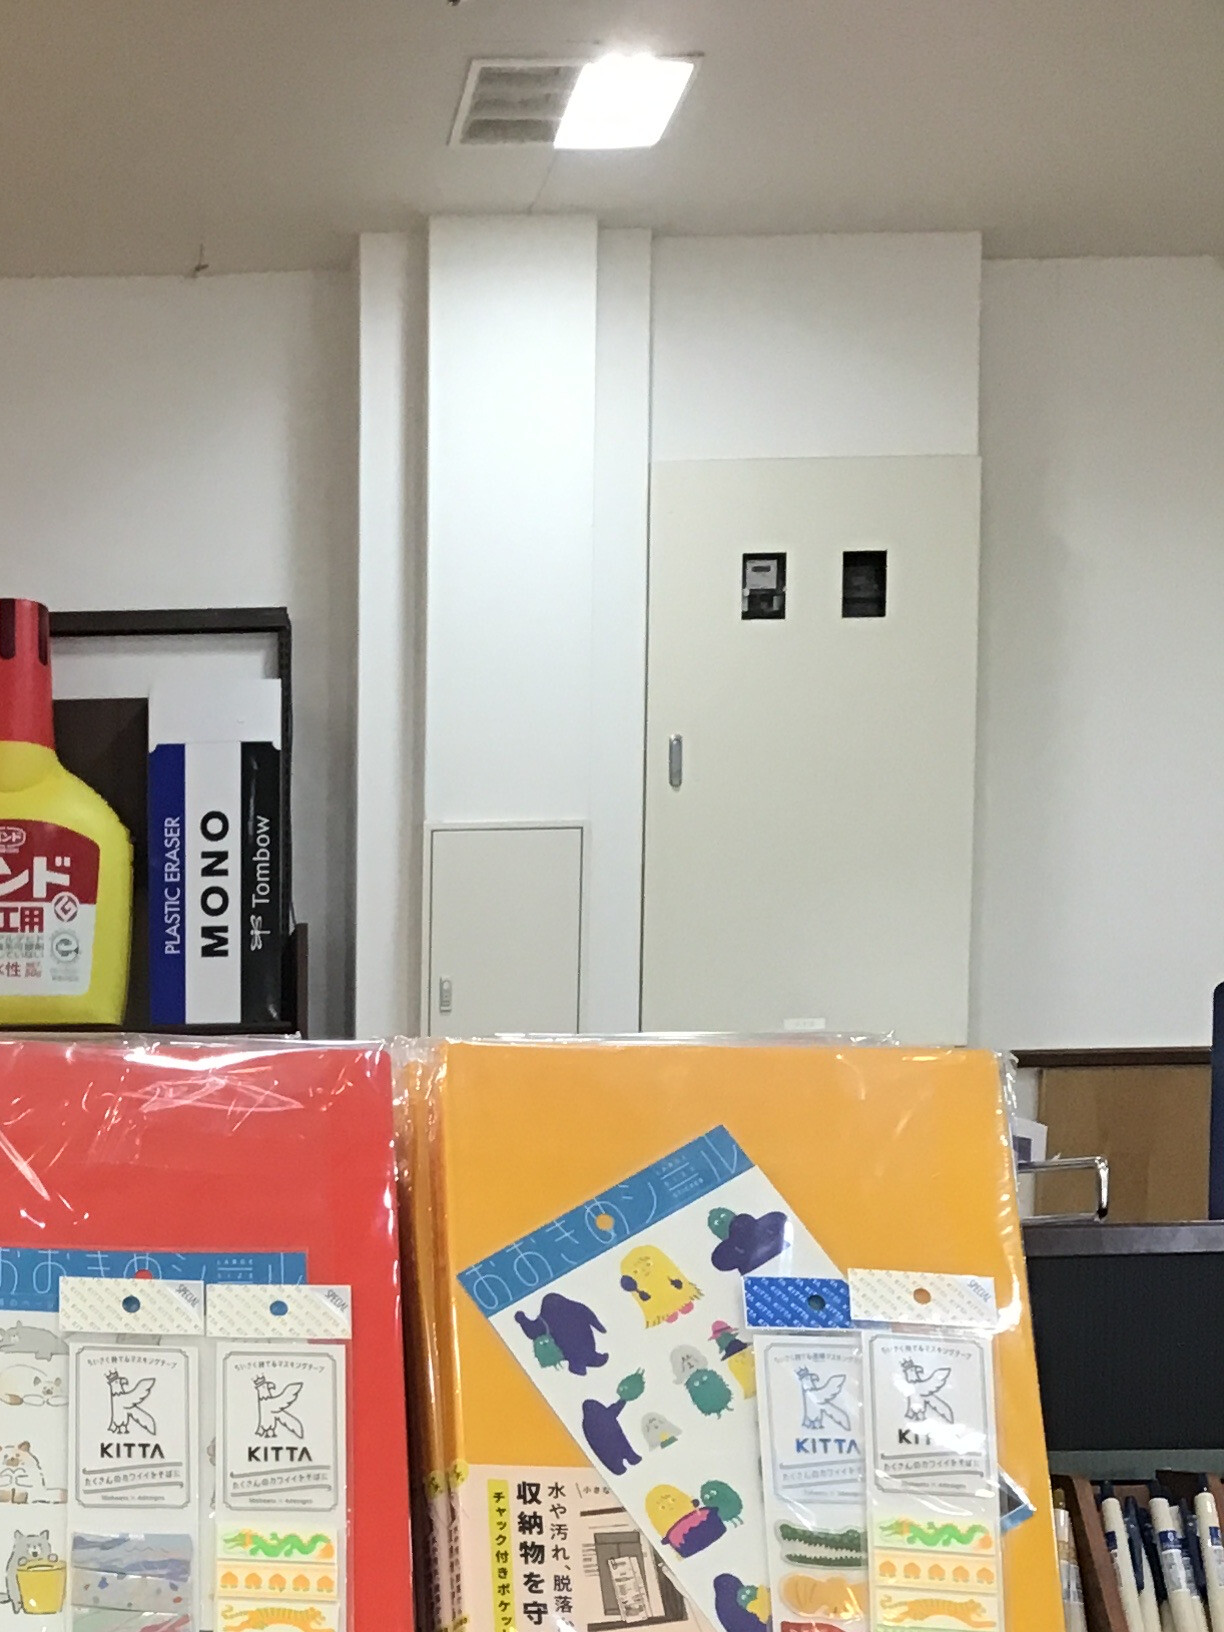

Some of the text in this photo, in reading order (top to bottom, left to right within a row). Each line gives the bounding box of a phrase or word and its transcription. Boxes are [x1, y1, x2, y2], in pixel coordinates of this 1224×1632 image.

[164, 817, 180, 954] PLASTIC ERASER
[200, 811, 229, 957] MONO
[252, 815, 270, 908] Tombow
[100, 1442, 165, 1459] KITTA
[247, 1446, 313, 1462] KITTA
